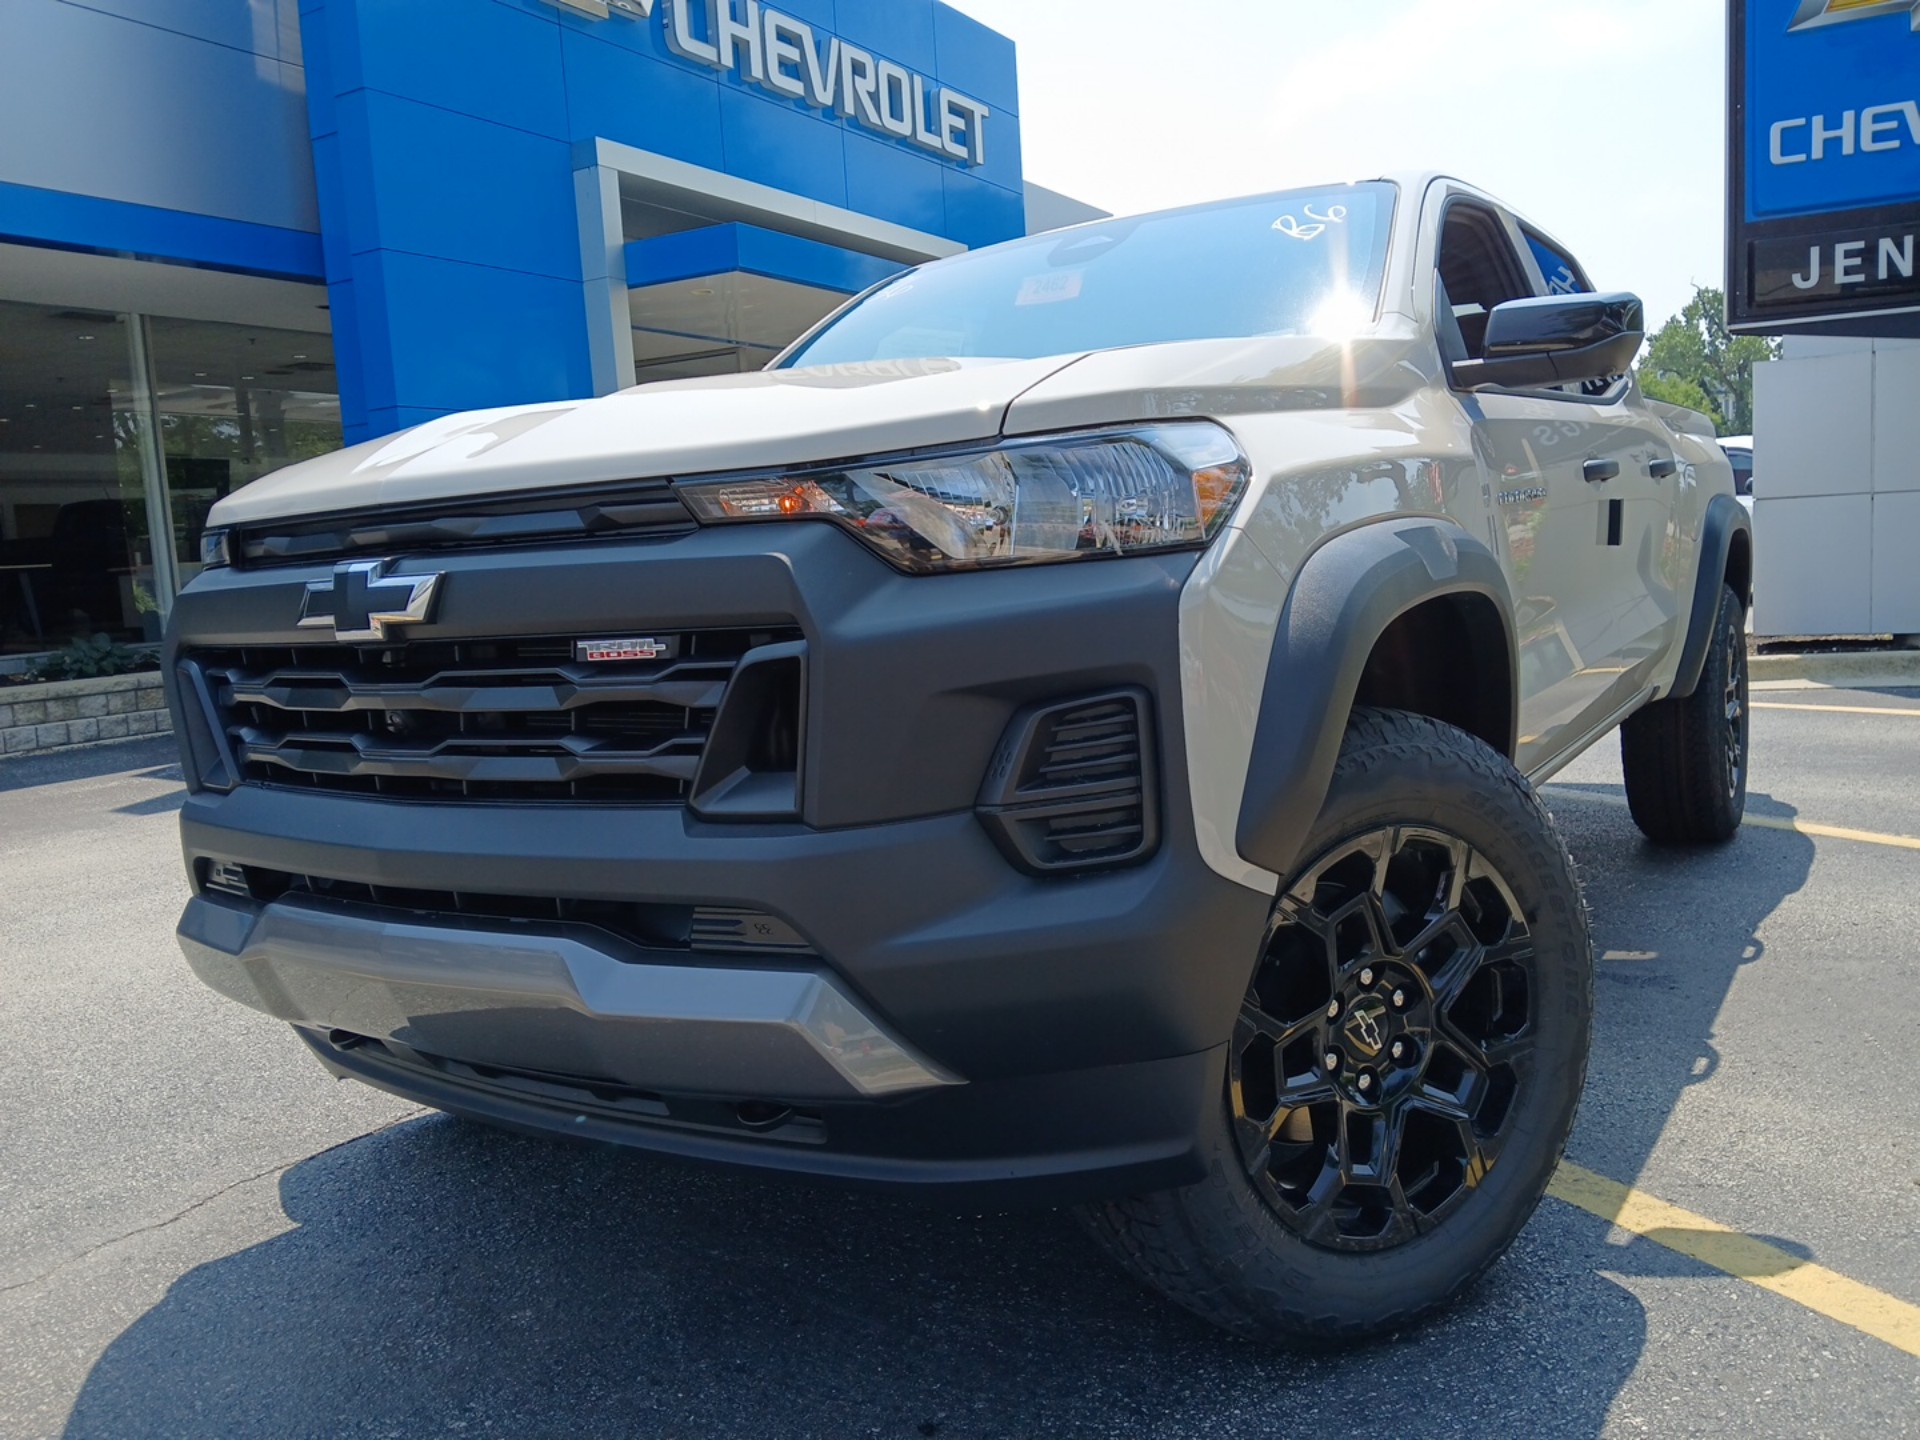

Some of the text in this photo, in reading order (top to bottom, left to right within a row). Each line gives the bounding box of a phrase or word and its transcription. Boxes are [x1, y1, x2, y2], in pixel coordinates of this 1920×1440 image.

[670, 0, 990, 166] CHEVROLET
[1791, 234, 1914, 289] JEN
[587, 649, 657, 661] BOSS
